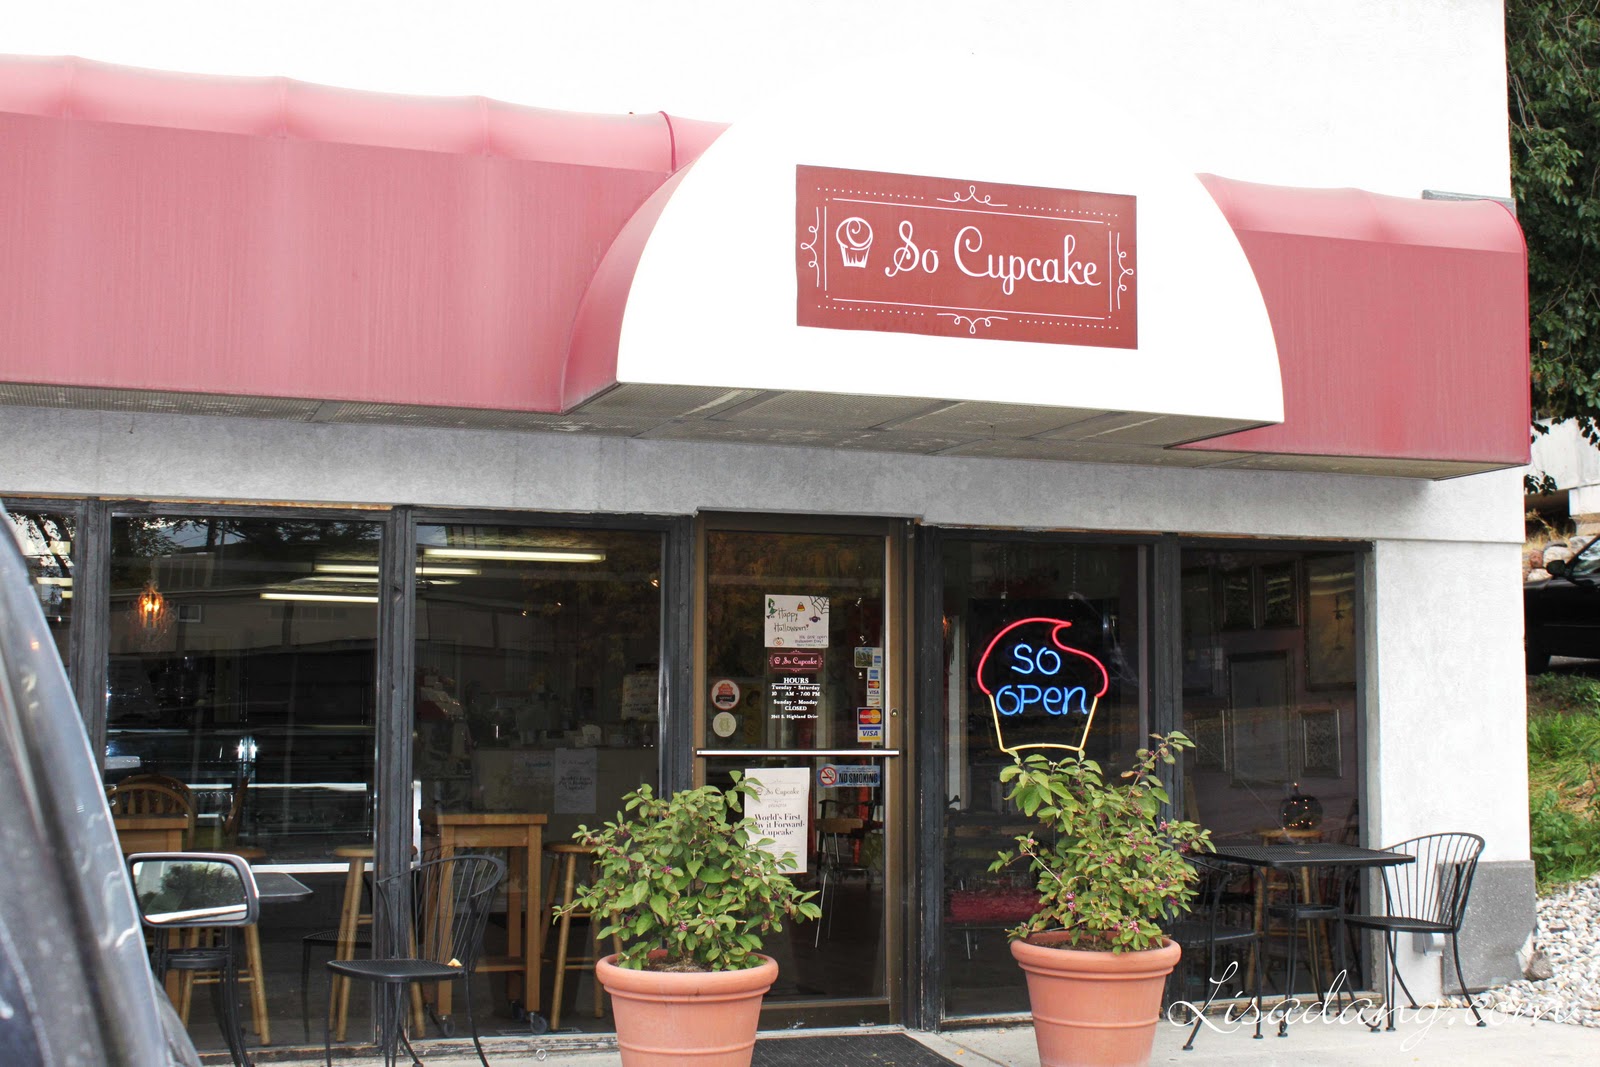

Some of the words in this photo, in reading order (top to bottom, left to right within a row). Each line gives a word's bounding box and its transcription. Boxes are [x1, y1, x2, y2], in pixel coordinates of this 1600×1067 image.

[884, 219, 939, 277] So
[954, 225, 1102, 295] Cupcake
[1011, 644, 1062, 675] SO
[839, 773, 847, 783] NO
[849, 773, 878, 783] SMOKING
[775, 786, 799, 796] Cupcake
[754, 813, 782, 821] World's
[784, 813, 801, 821] First
[762, 828, 794, 838] Cupcake
